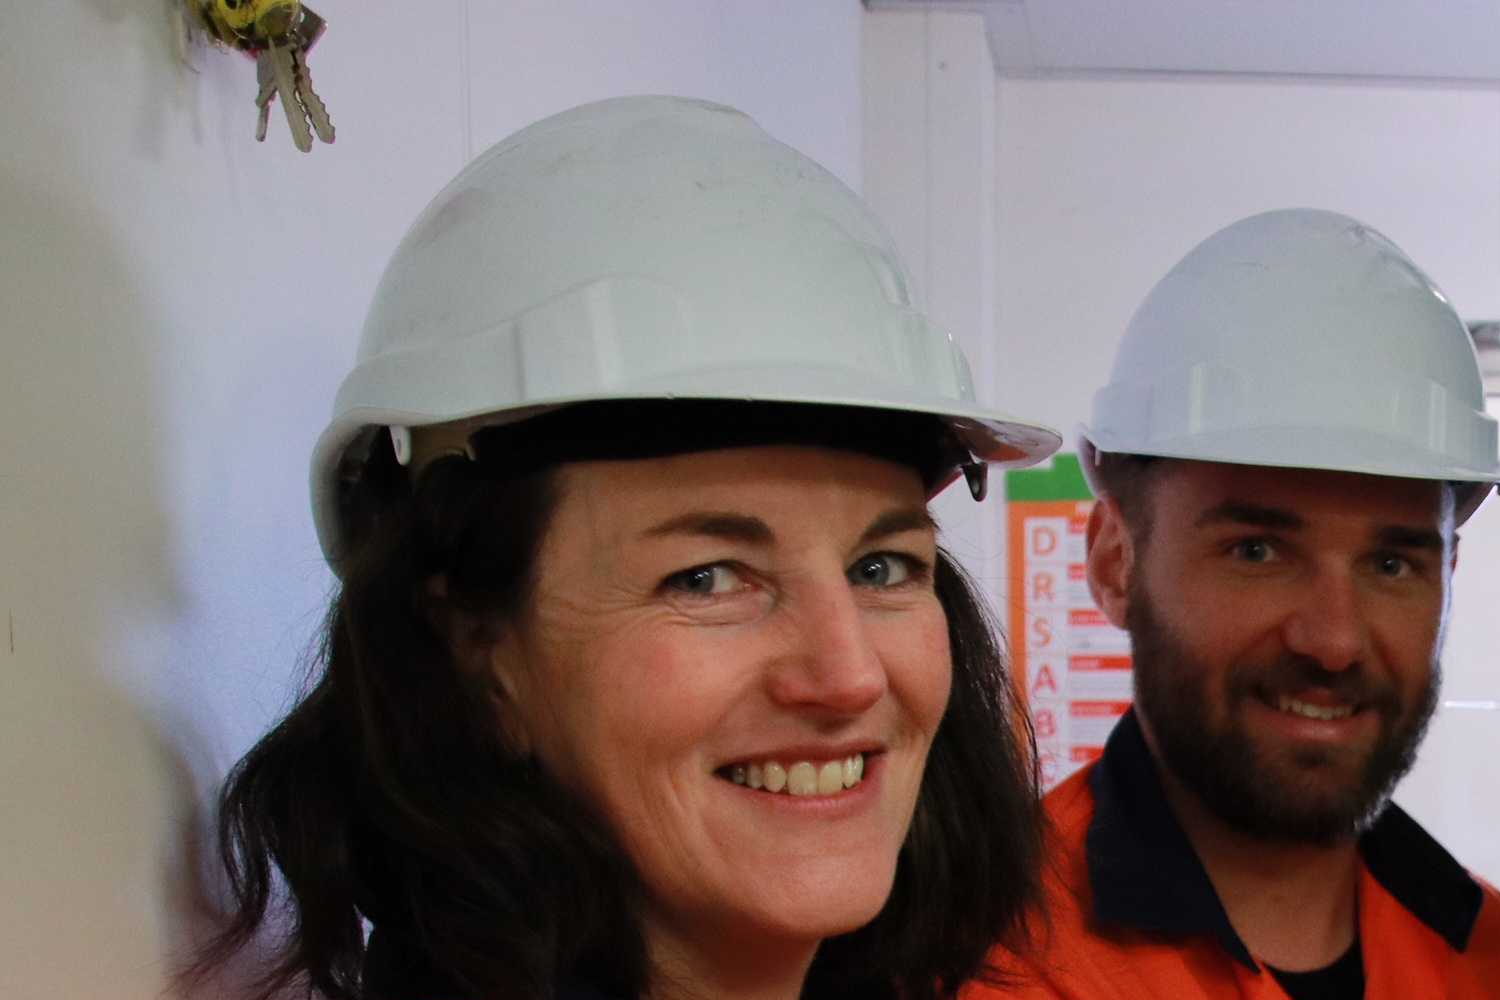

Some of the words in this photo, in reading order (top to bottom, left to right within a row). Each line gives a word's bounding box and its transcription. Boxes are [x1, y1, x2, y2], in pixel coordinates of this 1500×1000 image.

[1032, 526, 1057, 555] D
[1033, 573, 1055, 601] R
[1032, 617, 1053, 647] S
[1035, 664, 1058, 693] A
[1036, 711, 1055, 737] B
